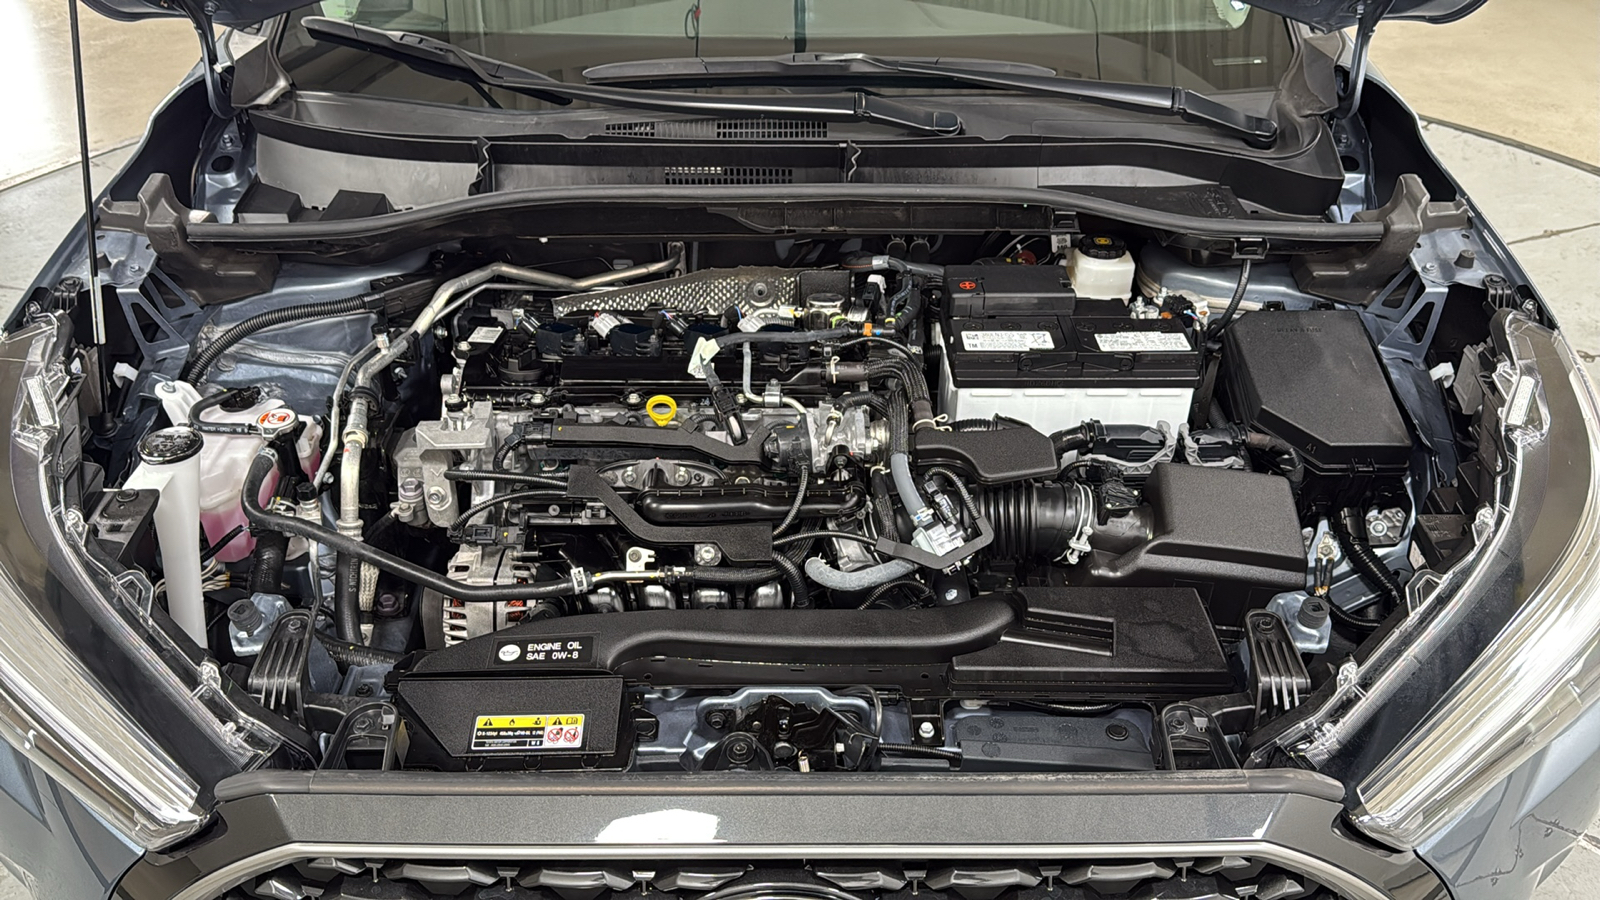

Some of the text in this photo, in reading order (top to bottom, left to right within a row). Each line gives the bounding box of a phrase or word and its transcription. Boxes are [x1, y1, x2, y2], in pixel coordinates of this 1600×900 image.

[1305, 442, 1317, 454] A1
[527, 641, 582, 651] ENGINE OIL
[525, 650, 579, 661] SAE 0W-8
